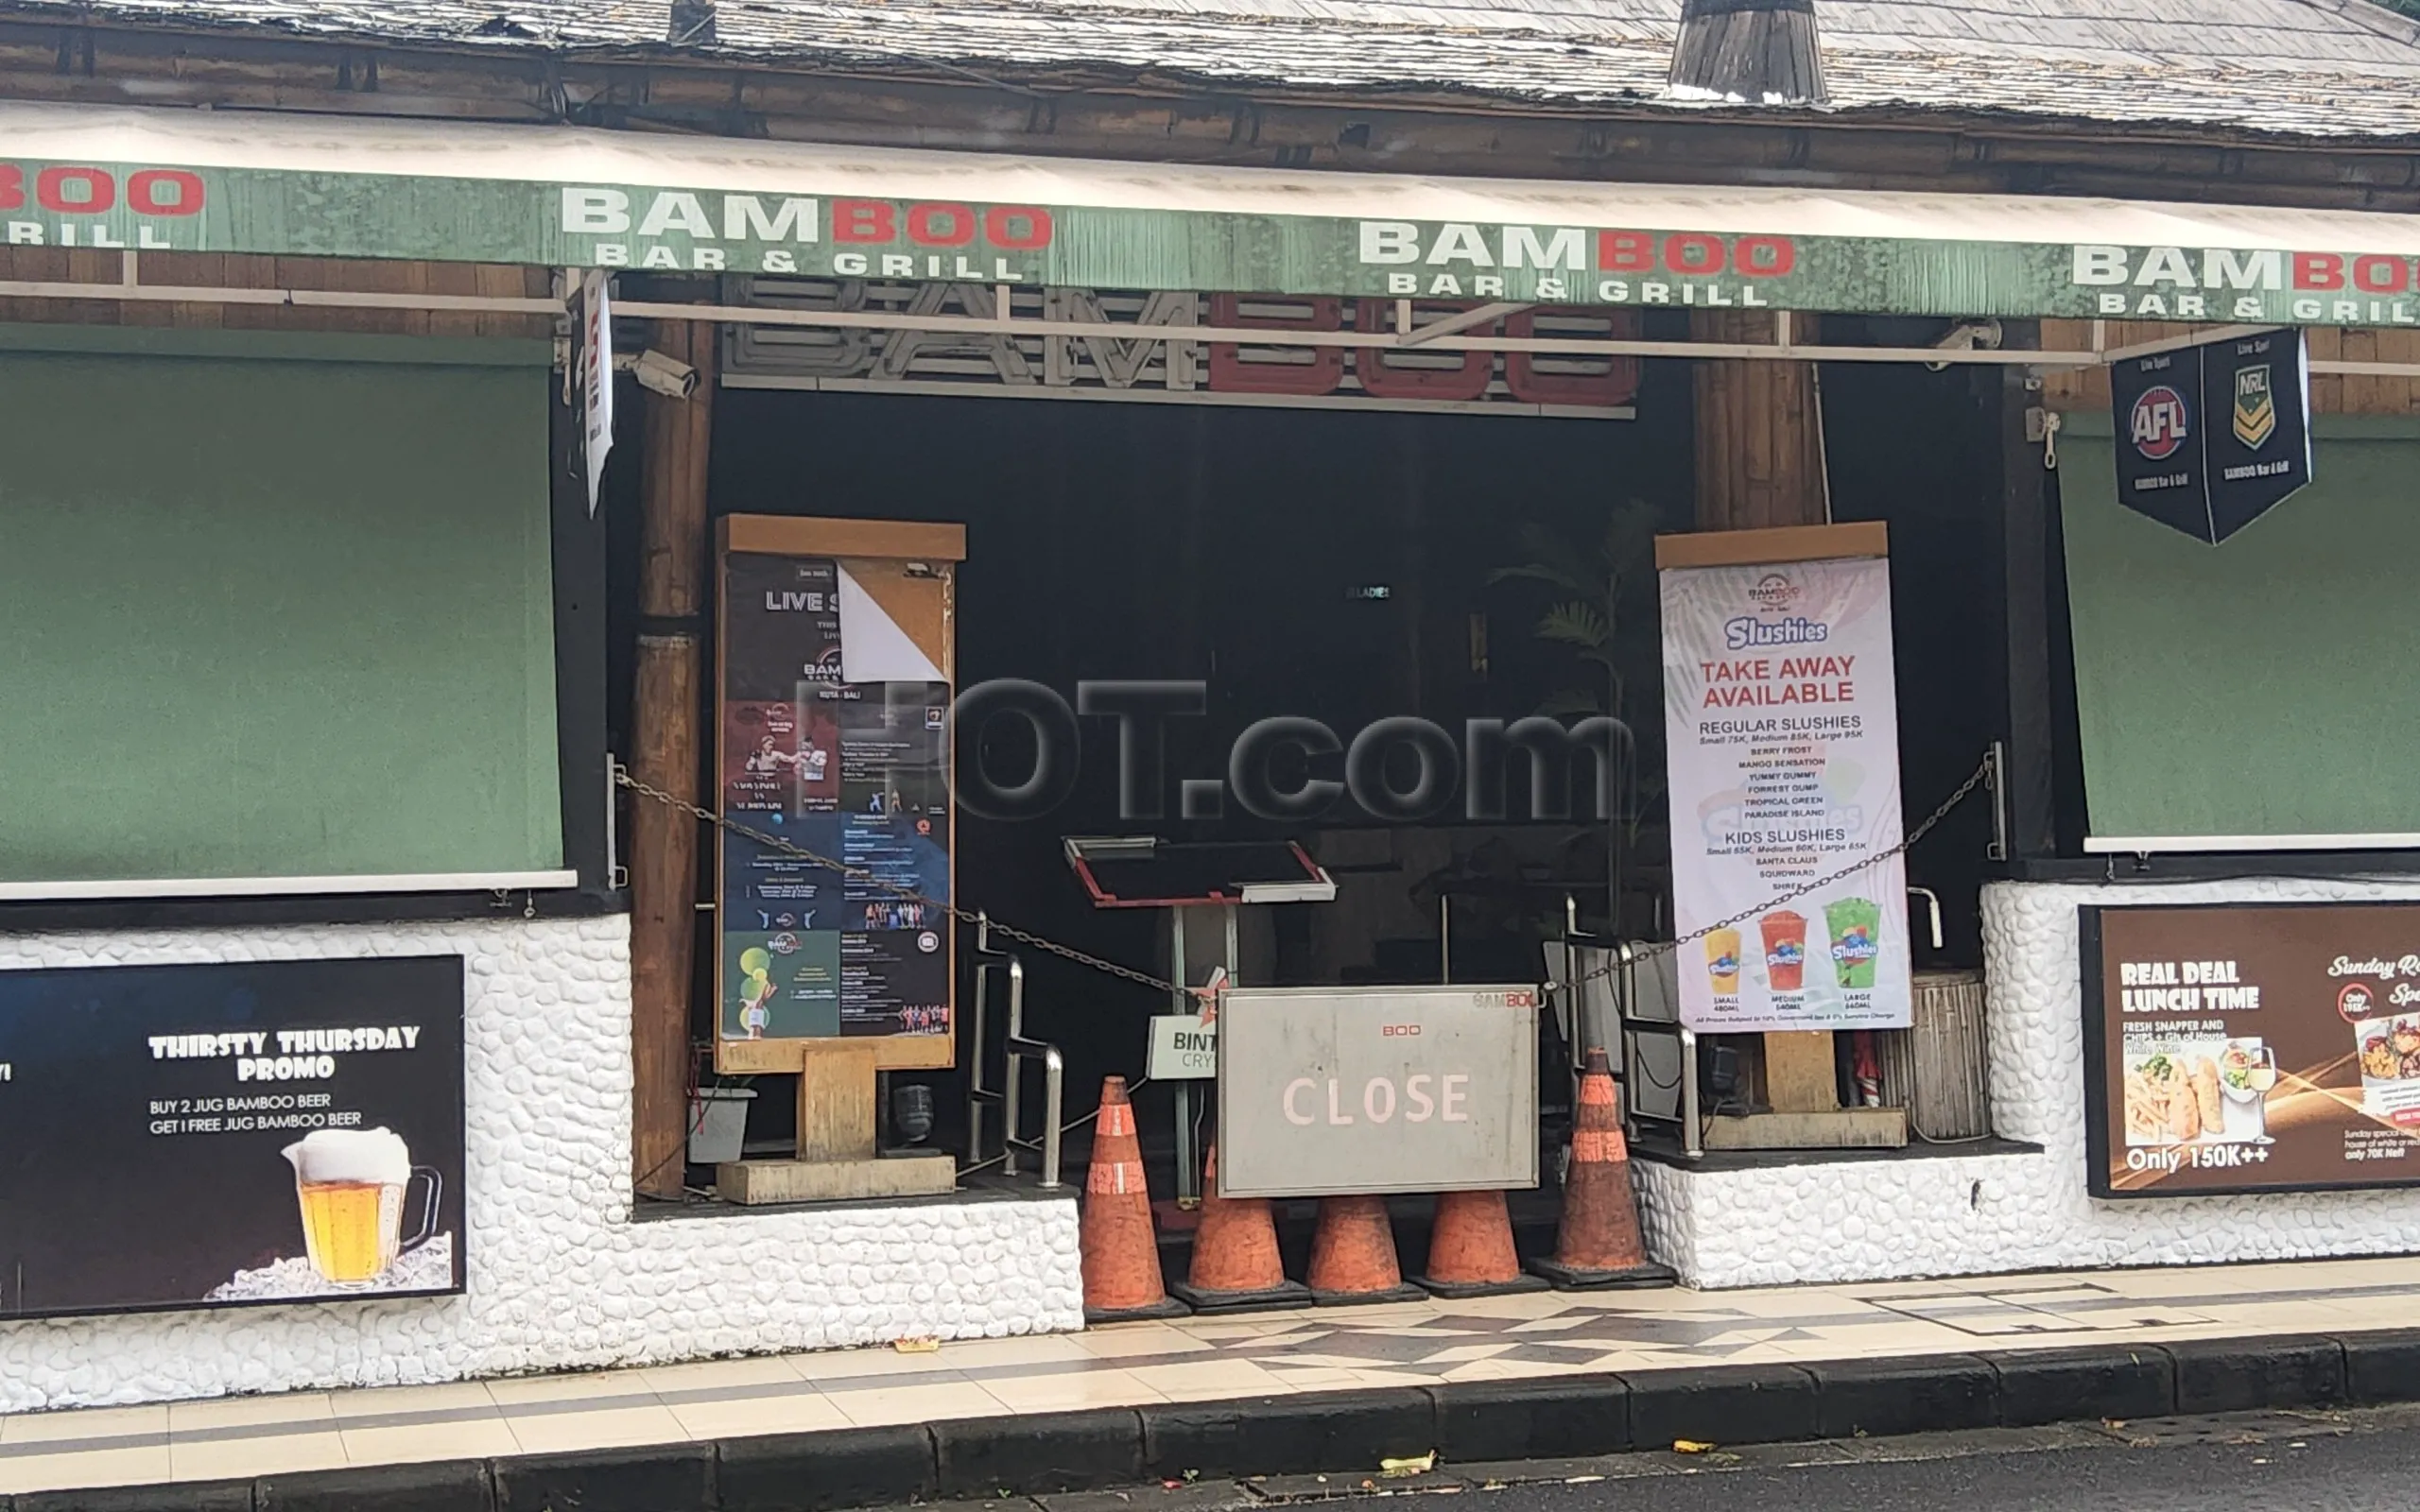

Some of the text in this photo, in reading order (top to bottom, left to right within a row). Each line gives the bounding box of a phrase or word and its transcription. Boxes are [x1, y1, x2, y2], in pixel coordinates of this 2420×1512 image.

[562, 187, 1053, 249] BAMBOO
[596, 243, 1023, 281] BAR & GRILL
[1359, 220, 1794, 279] BAMBOO
[2073, 245, 2420, 295] BAMBO
[1389, 272, 1768, 307] BAR & GRILL
[2100, 293, 2204, 317] BAR
[2234, 298, 2264, 318] &
[2239, 371, 2266, 397] NRL
[2132, 401, 2187, 444] AFL
[766, 591, 823, 611] LIVE
[1724, 616, 1828, 650] Slushies
[1701, 655, 1855, 683] TAKE AWAY
[1703, 681, 1854, 709] AVAILABLE
[1700, 715, 1861, 734] REGULAR SLUSHIES
[1700, 736, 1725, 745] Small
[1752, 733, 1789, 743] Medium
[1814, 731, 1841, 741] Large
[1782, 746, 1812, 754] FROST
[1738, 758, 1825, 768] MANGO SENSATION
[1748, 785, 1789, 794] FORREST
[1744, 799, 1789, 807] TROPICAL
[1744, 809, 1824, 819] PARADISE ISLAND
[1706, 847, 1732, 855] Small
[1757, 844, 1793, 853] Medium
[1819, 843, 1846, 852] Large
[1725, 828, 1845, 845] KIDS SLUSHIES
[1755, 856, 1818, 866] SANTA CLAUS
[1759, 869, 1815, 878] SQUIDWARD
[2120, 960, 2240, 986] REAL DEAL
[2327, 955, 2396, 980] Sunday
[2121, 986, 2260, 1012] LUNCH TIME
[2123, 1020, 2224, 1032] FRESH SNAPPER AND
[2123, 1032, 2153, 1041] CHIPS
[2195, 1031, 2227, 1041] House
[148, 1026, 421, 1059] THIRSTY THURSDAY
[237, 1056, 336, 1082] PROMO
[150, 1093, 332, 1114] BUY 2 JUG BAMBOO BEER
[1283, 1074, 1469, 1125] CLOSE
[150, 1120, 179, 1134] GET
[189, 1118, 221, 1132] FREE
[224, 1116, 255, 1131] JUG
[258, 1114, 325, 1129] BAMBOO
[328, 1112, 362, 1126] BEER
[2127, 1144, 2269, 1174] Only 150K++
